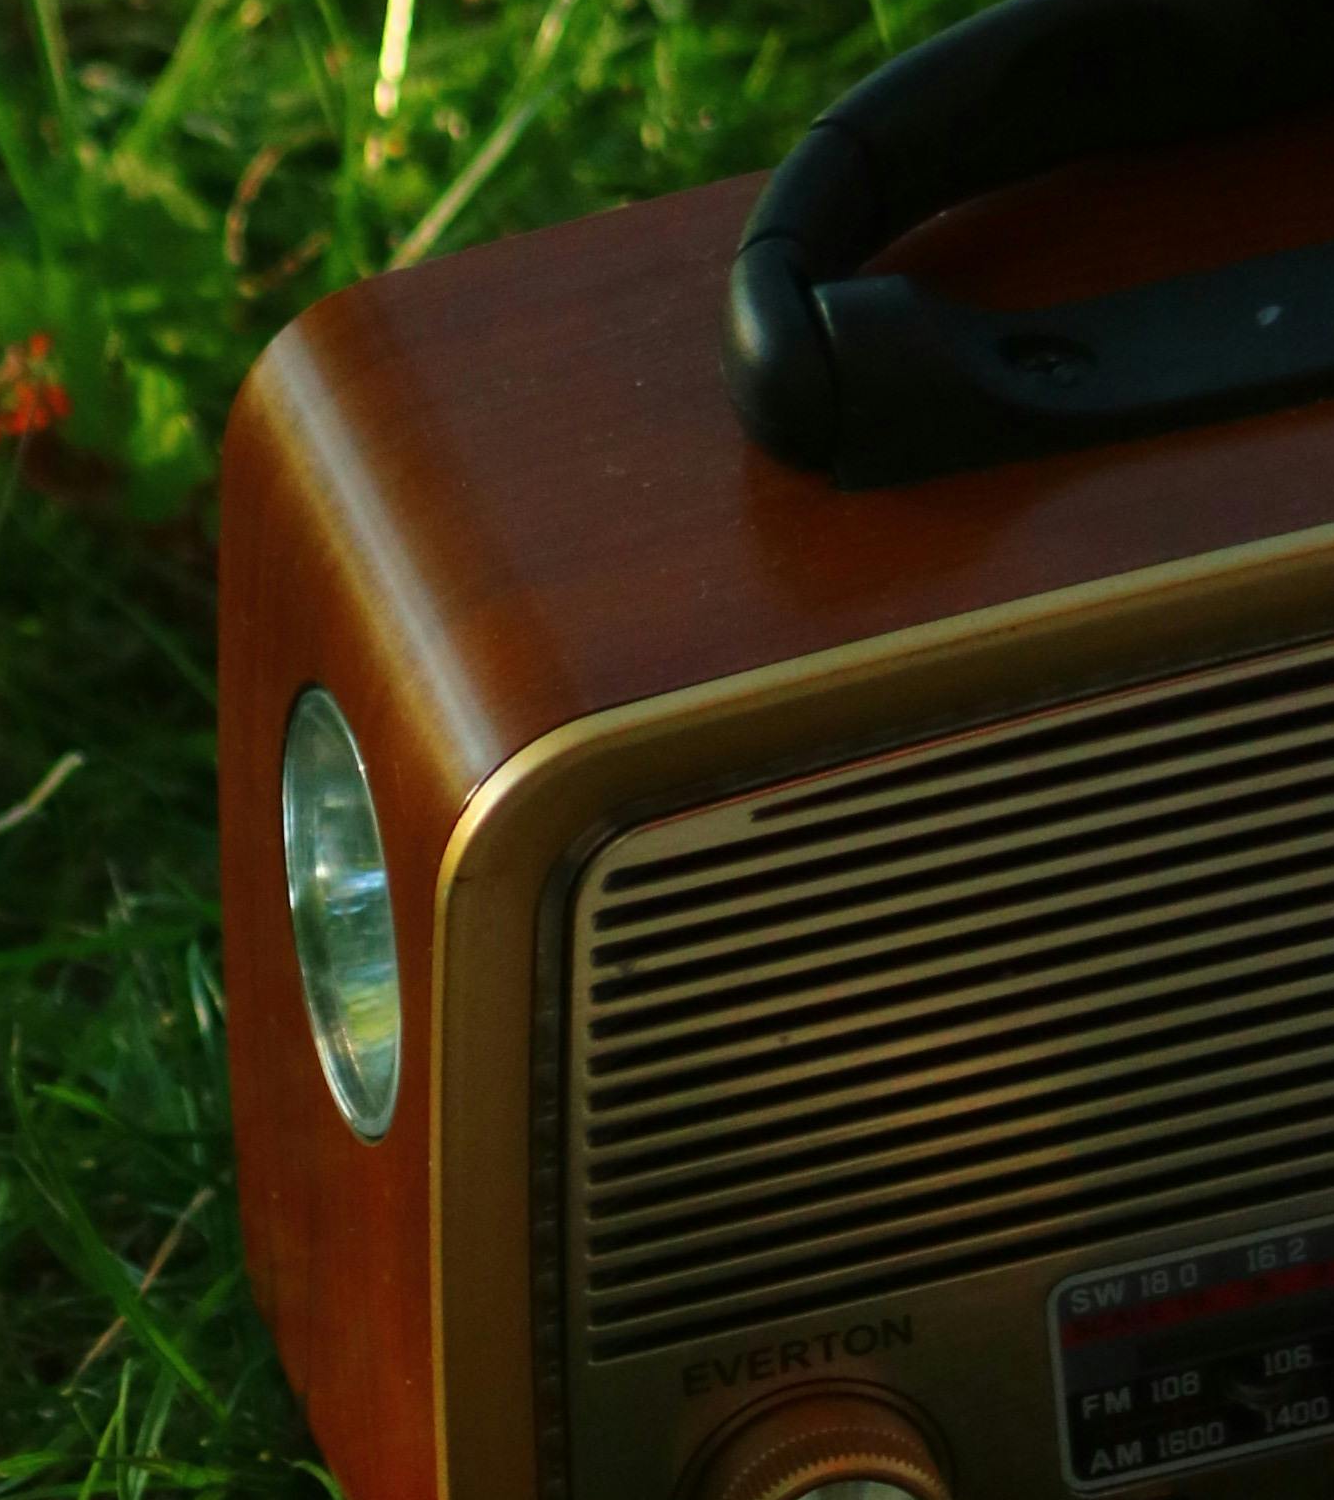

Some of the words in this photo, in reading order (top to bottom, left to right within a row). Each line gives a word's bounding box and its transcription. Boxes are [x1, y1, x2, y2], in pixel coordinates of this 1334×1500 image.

[1069, 1280, 1126, 1315] SW
[681, 1314, 914, 1397] EVERTON
[1080, 1384, 1131, 1420] FM
[1150, 1369, 1201, 1404] 108
[1262, 1344, 1314, 1377] 106
[1090, 1440, 1142, 1476] AM
[1156, 1420, 1226, 1458] 1600
[1263, 1395, 1331, 1435] 1400
